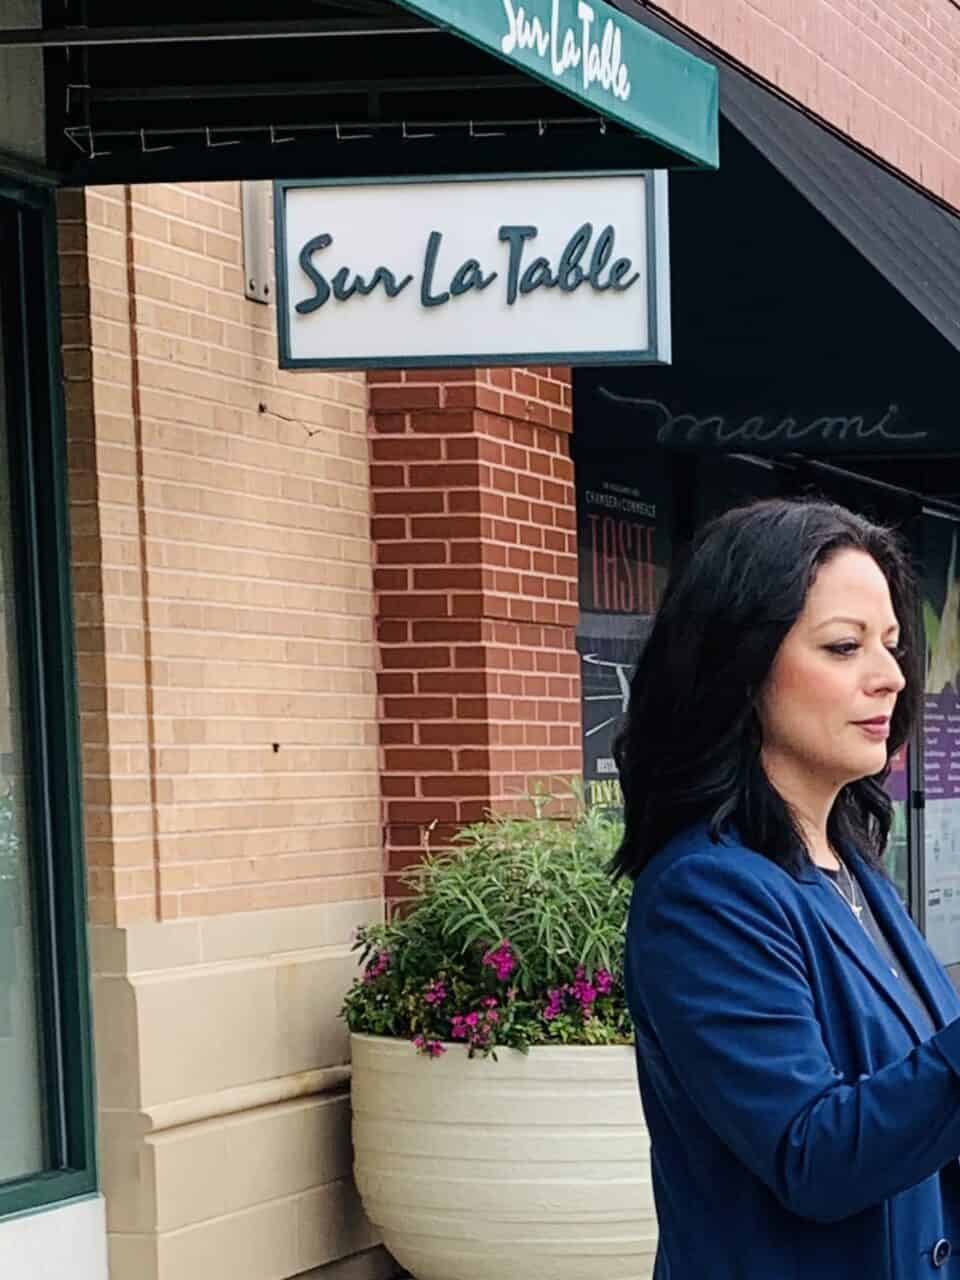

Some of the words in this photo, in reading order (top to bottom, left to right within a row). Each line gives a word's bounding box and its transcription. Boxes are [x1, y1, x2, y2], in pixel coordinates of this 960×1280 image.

[577, 0, 631, 101] Table
[296, 233, 413, 314] Sur
[420, 231, 499, 308] La
[499, 222, 640, 306] Table
